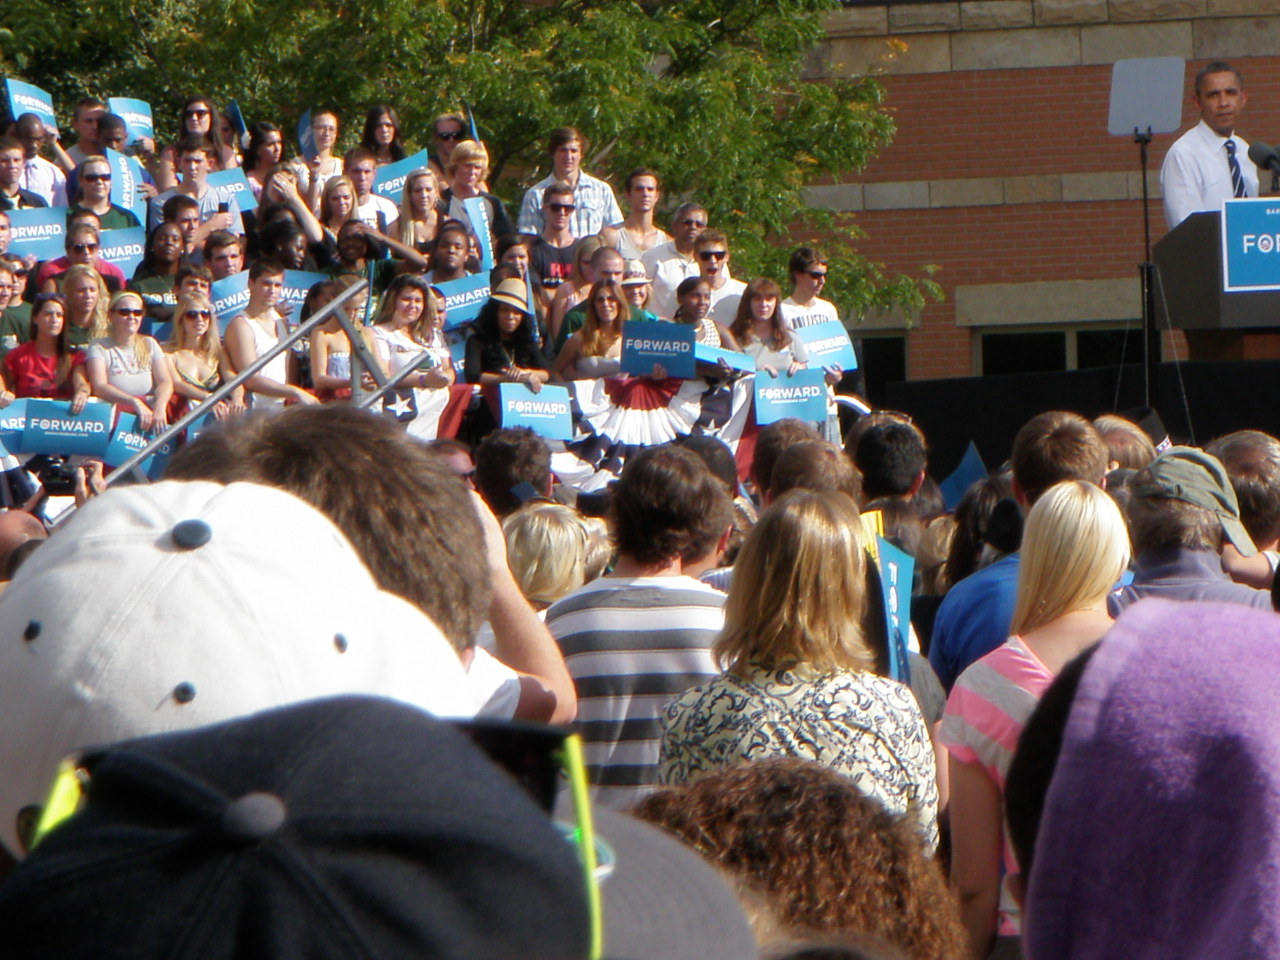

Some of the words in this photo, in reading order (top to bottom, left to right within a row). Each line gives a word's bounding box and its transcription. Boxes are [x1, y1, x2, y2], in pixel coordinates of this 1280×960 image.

[98, 244, 144, 260] RWARD.
[445, 288, 491, 306] RWARD
[31, 419, 105, 433] FORWARD.
